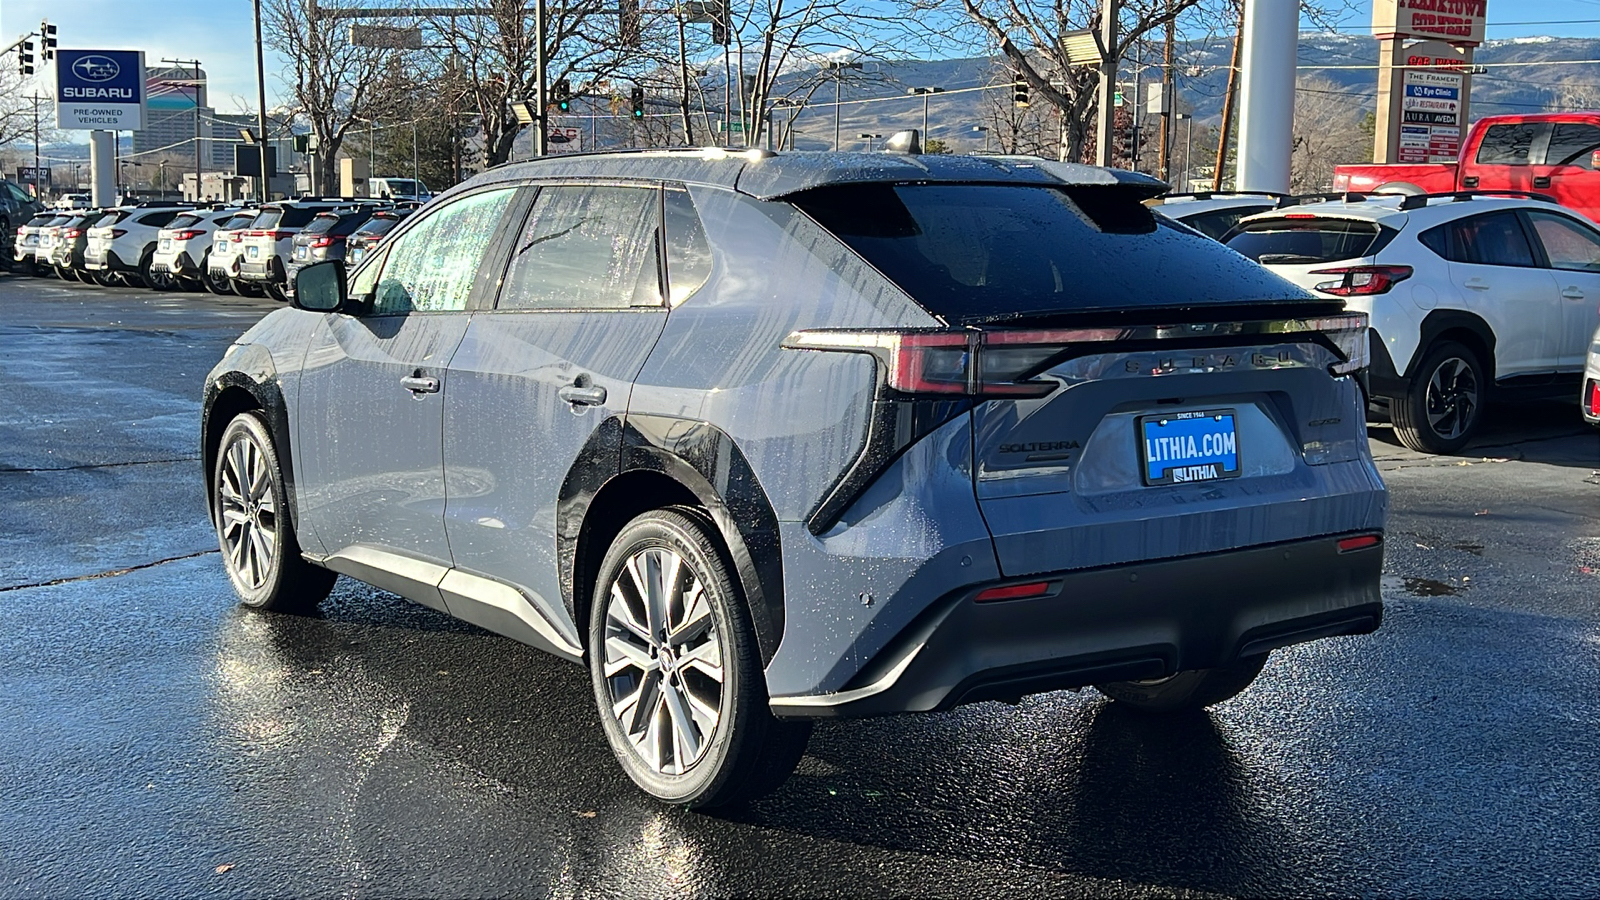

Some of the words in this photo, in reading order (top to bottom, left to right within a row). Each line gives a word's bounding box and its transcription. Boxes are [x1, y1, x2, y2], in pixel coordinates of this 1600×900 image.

[1412, 13, 1472, 37] CORNERS
[1408, 55, 1431, 67] CAR
[1426, 74, 1460, 83] FRAMERY
[63, 87, 132, 98] SUBARU
[1423, 87, 1434, 97] Eye
[1435, 88, 1452, 97] Clinic
[73, 108, 123, 116] PRE-OWNED
[1406, 112, 1430, 122] AURA
[1434, 114, 1456, 123] AVEDA
[1125, 351, 1293, 374] SUBARU
[999, 440, 1080, 454] SOLTERRA
[1146, 431, 1237, 463] LITHIA.COM
[1183, 464, 1218, 481] LITHIA
